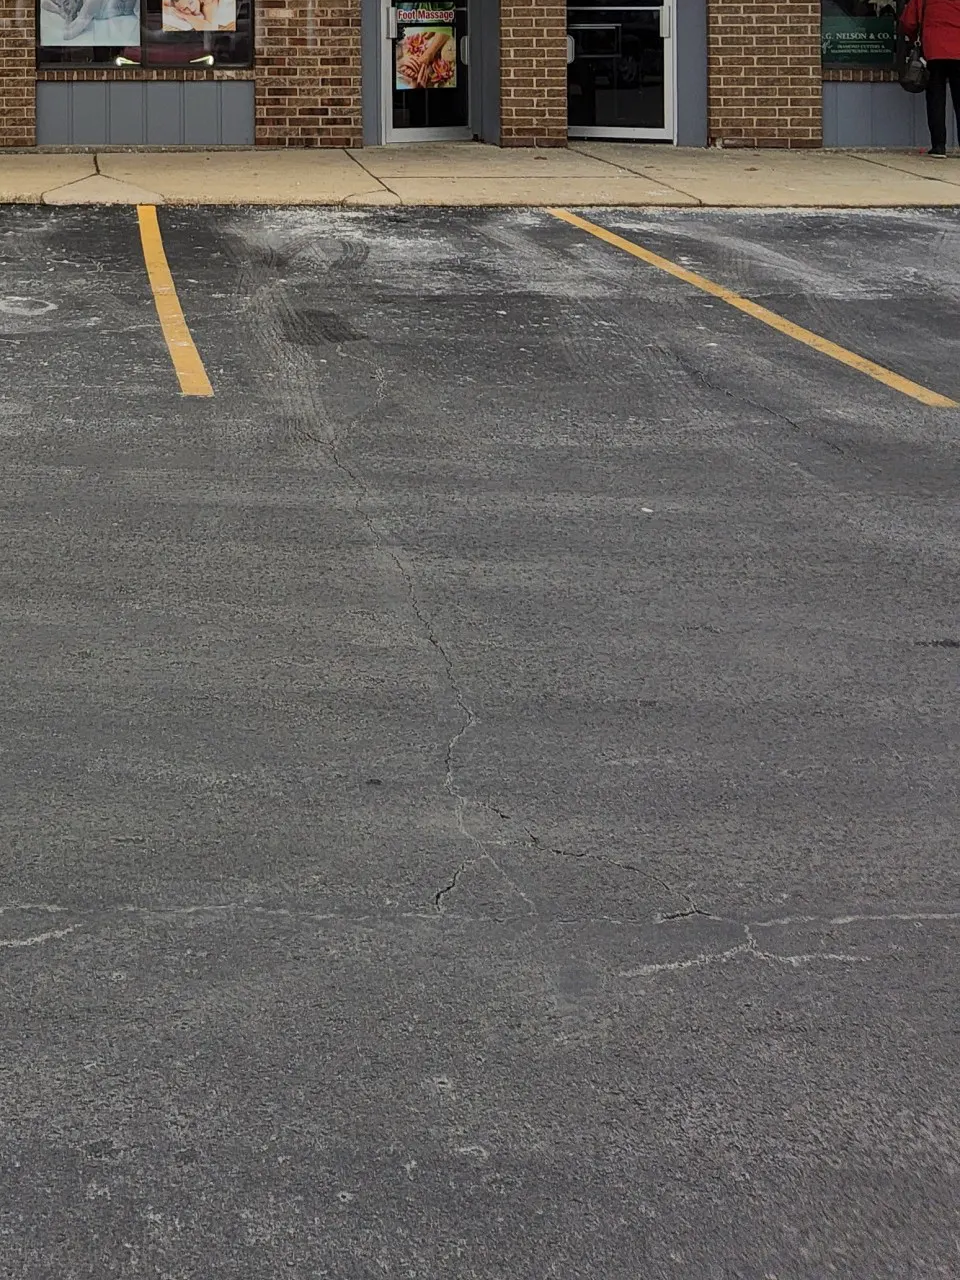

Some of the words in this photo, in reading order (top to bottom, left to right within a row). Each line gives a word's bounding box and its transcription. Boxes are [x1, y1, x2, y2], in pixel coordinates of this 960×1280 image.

[398, 9, 416, 20] Foot
[418, 9, 455, 22] Massage
[836, 32, 867, 40] NELSON
[869, 32, 876, 40] &
[877, 32, 892, 40] CO.
